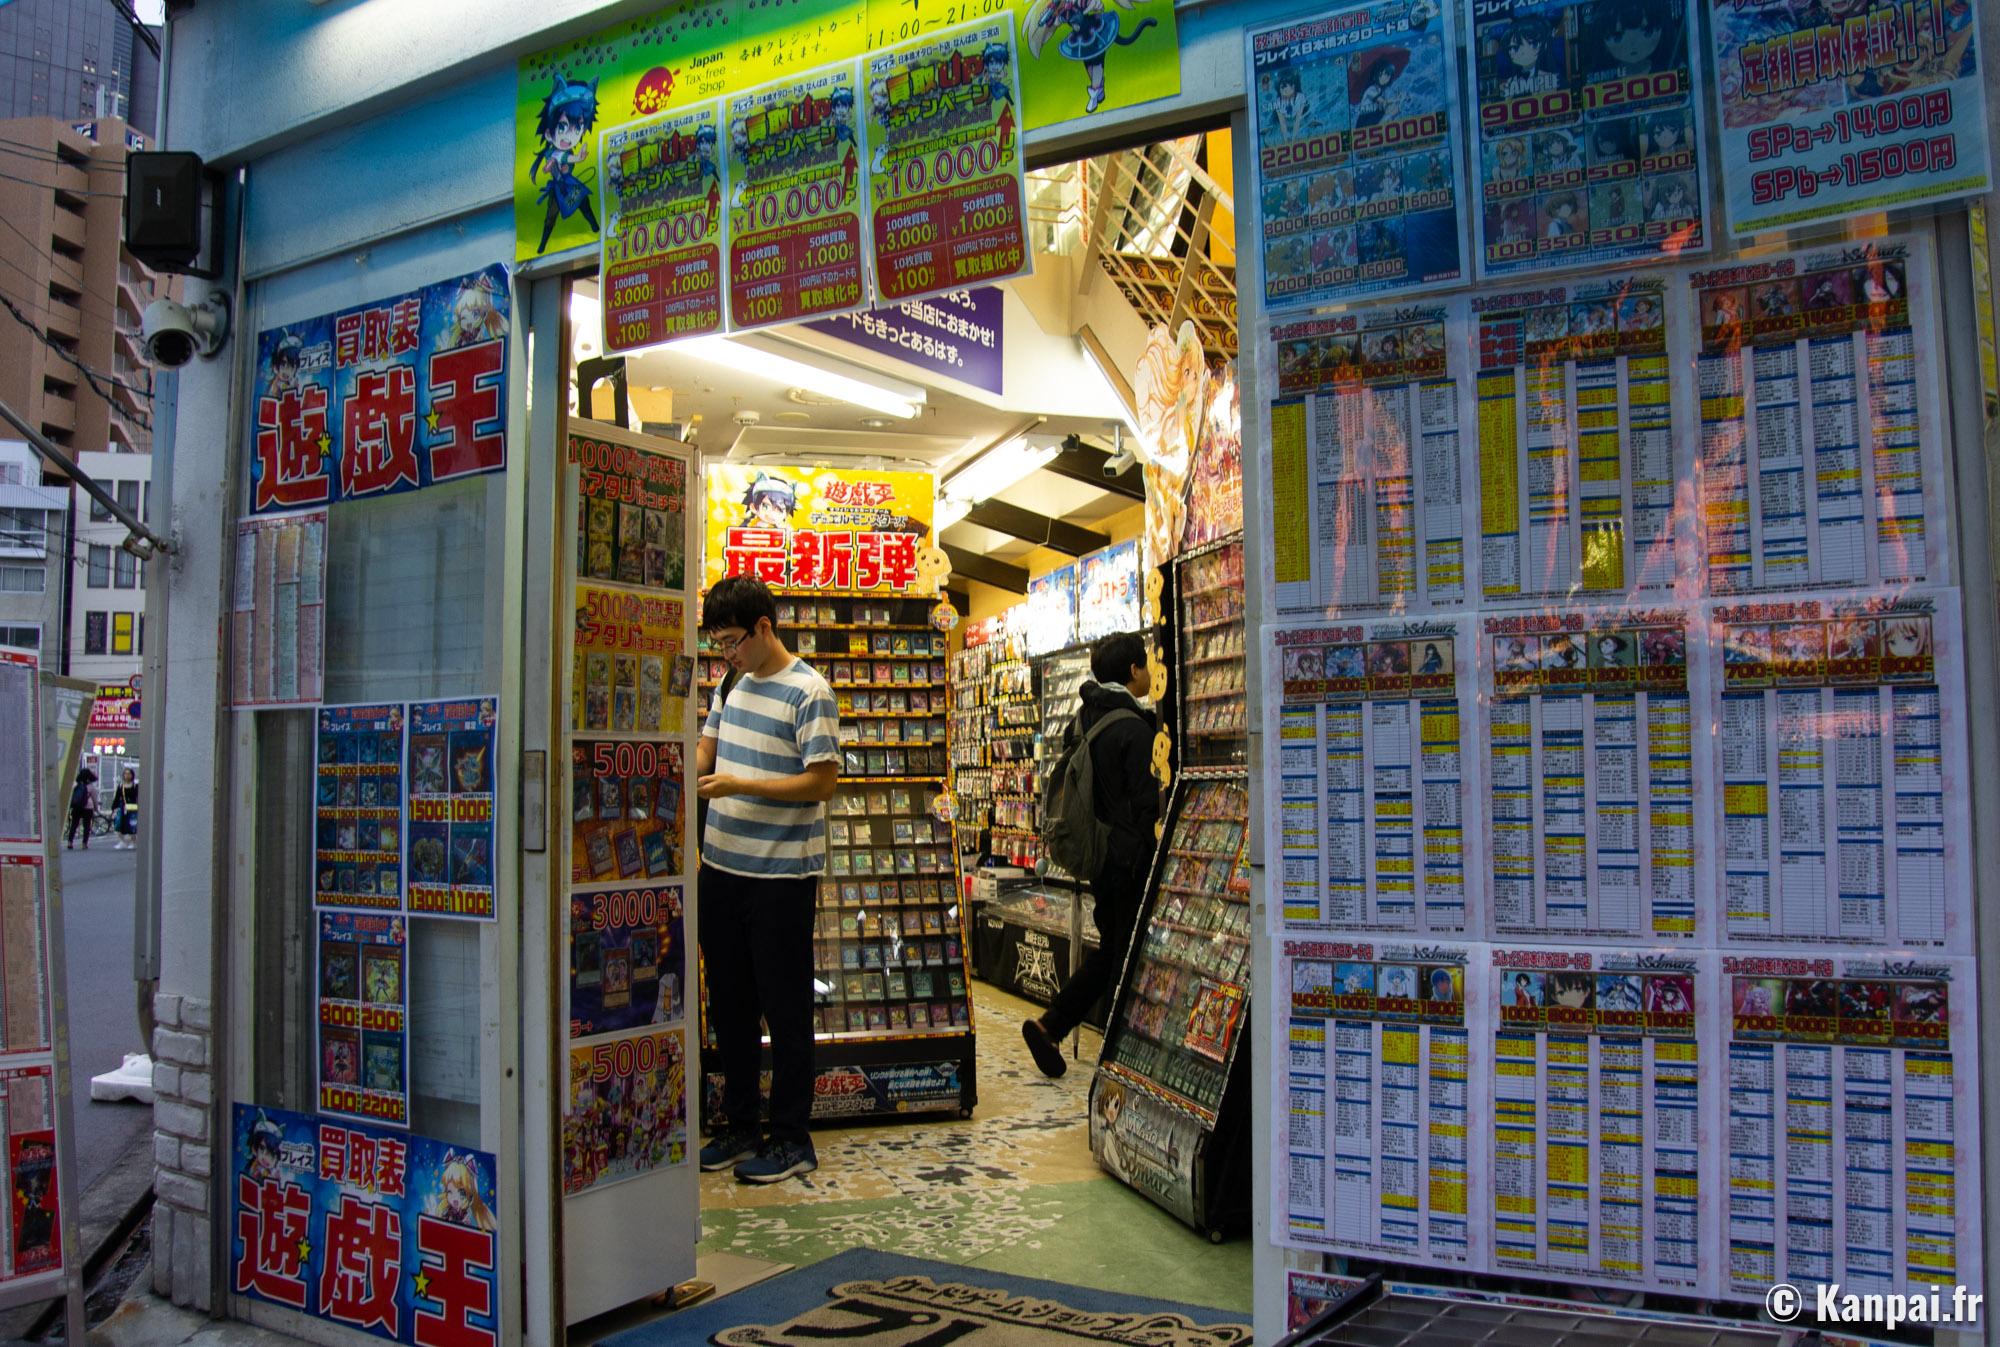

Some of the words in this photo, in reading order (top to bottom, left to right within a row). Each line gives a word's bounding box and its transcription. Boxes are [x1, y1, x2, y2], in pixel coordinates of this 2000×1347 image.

[739, 12, 865, 61] 各種クレジットカード
[773, 41, 828, 66] 使えます。
[1256, 19, 1410, 66] プレイズ日本橋オタロード店
[690, 52, 722, 70] Japan
[698, 80, 725, 96] Shop
[888, 83, 991, 127] キャンペーン
[1482, 92, 1571, 126] 900
[1583, 72, 1678, 109] 1200
[1834, 88, 1953, 144] 1400円
[1262, 135, 1341, 170] 22000
[1353, 115, 1437, 150] 25000
[1841, 133, 1957, 186] 1500円
[1484, 178, 1530, 198] 800
[1535, 168, 1583, 189] 250
[1587, 160, 1637, 181] 50
[1641, 151, 1691, 172] 900
[962, 193, 1005, 213] 50枚買取
[1265, 218, 1305, 235] 8000
[1310, 208, 1350, 226] 6000
[1357, 199, 1399, 218] 7000
[886, 211, 930, 232] 100枚買取
[1487, 240, 1532, 259] 100
[1537, 232, 1585, 252] 350
[1591, 224, 1640, 245] 30
[894, 251, 933, 271] 10枚買取
[954, 247, 1021, 279] 買取強化中
[1267, 276, 1307, 295] 7000
[1313, 267, 1354, 285] 6000
[335, 297, 421, 369] 買取表
[256, 337, 507, 512] 遊戯王
[569, 438, 627, 474] 1000
[824, 480, 897, 506] 遊戯王
[810, 512, 909, 528] デュエルモンスターズ
[723, 526, 919, 592] 最新弾
[586, 590, 623, 620] 500
[594, 743, 656, 778] 500
[410, 800, 445, 821] 1500
[450, 800, 487, 822] 1000
[410, 890, 445, 911] 1300
[450, 890, 487, 913] 1100
[593, 890, 656, 930] 3000
[320, 1004, 355, 1027] 800
[361, 1008, 399, 1031] 200
[593, 1037, 656, 1083] 500
[815, 1074, 867, 1096] 遊戯王
[320, 1089, 355, 1112] 100
[361, 1094, 399, 1120] 2200
[279, 1150, 315, 1168] プレイズ
[319, 1124, 407, 1199] 買取表
[237, 1173, 498, 1347] 遊戯王
[884, 1278, 1136, 1334] カードゲームショップ
